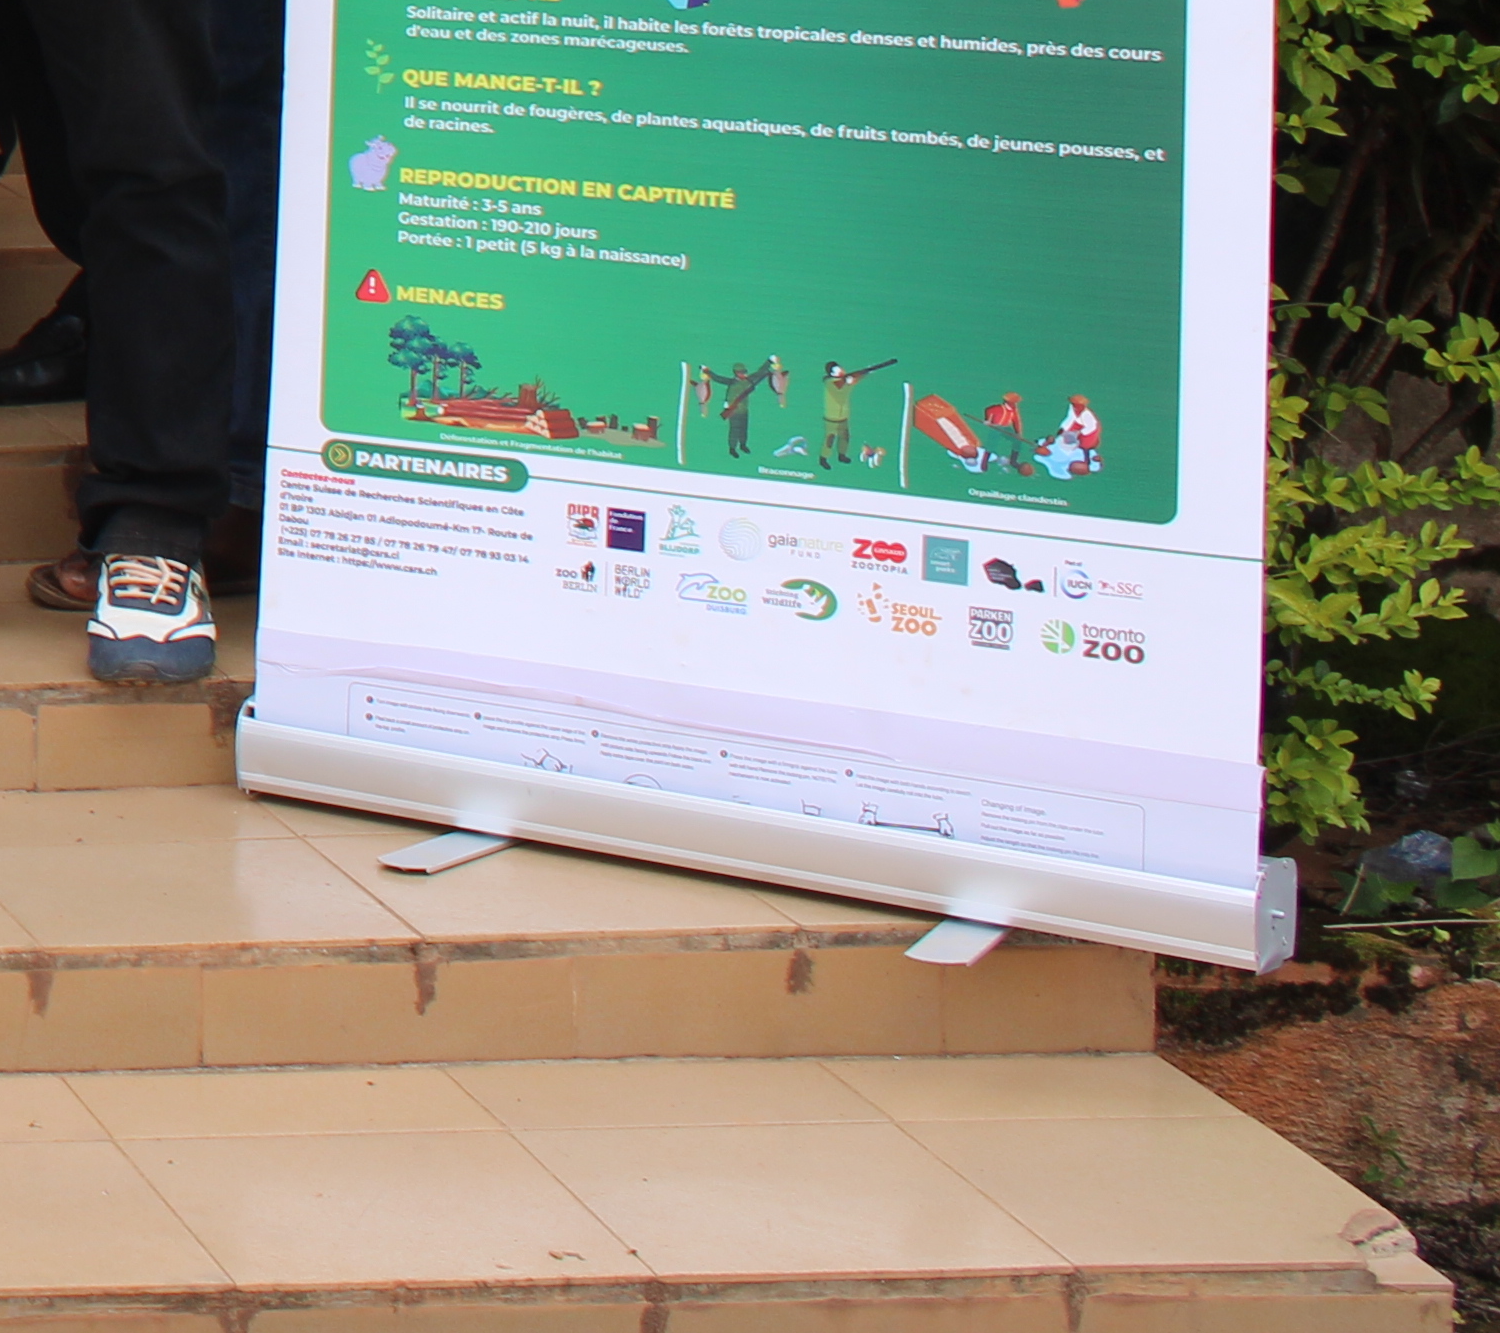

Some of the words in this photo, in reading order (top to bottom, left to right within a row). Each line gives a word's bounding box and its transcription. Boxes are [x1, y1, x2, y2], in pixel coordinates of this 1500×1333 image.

[402, 68, 450, 90] QUE
[454, 71, 584, 96] MANGE-T-IL
[588, 80, 602, 97] ?
[400, 167, 577, 195] REPRODUCTION
[583, 181, 612, 200] EN
[617, 181, 737, 210] CAPTIVITÉ
[396, 285, 505, 310] MENACES
[355, 448, 511, 484] PARTENAIRES
[555, 568, 578, 579] ZOO
[851, 561, 909, 575] ZOOTOPIA
[706, 585, 747, 603] ZOO
[1067, 579, 1092, 590] IUCN
[891, 602, 943, 621] SEOUL
[969, 606, 1013, 623] PARKEN
[891, 616, 937, 637] ZOO
[968, 619, 1014, 644] ZOO
[1082, 623, 1146, 645] toronto
[1082, 639, 1145, 664] ZOO
